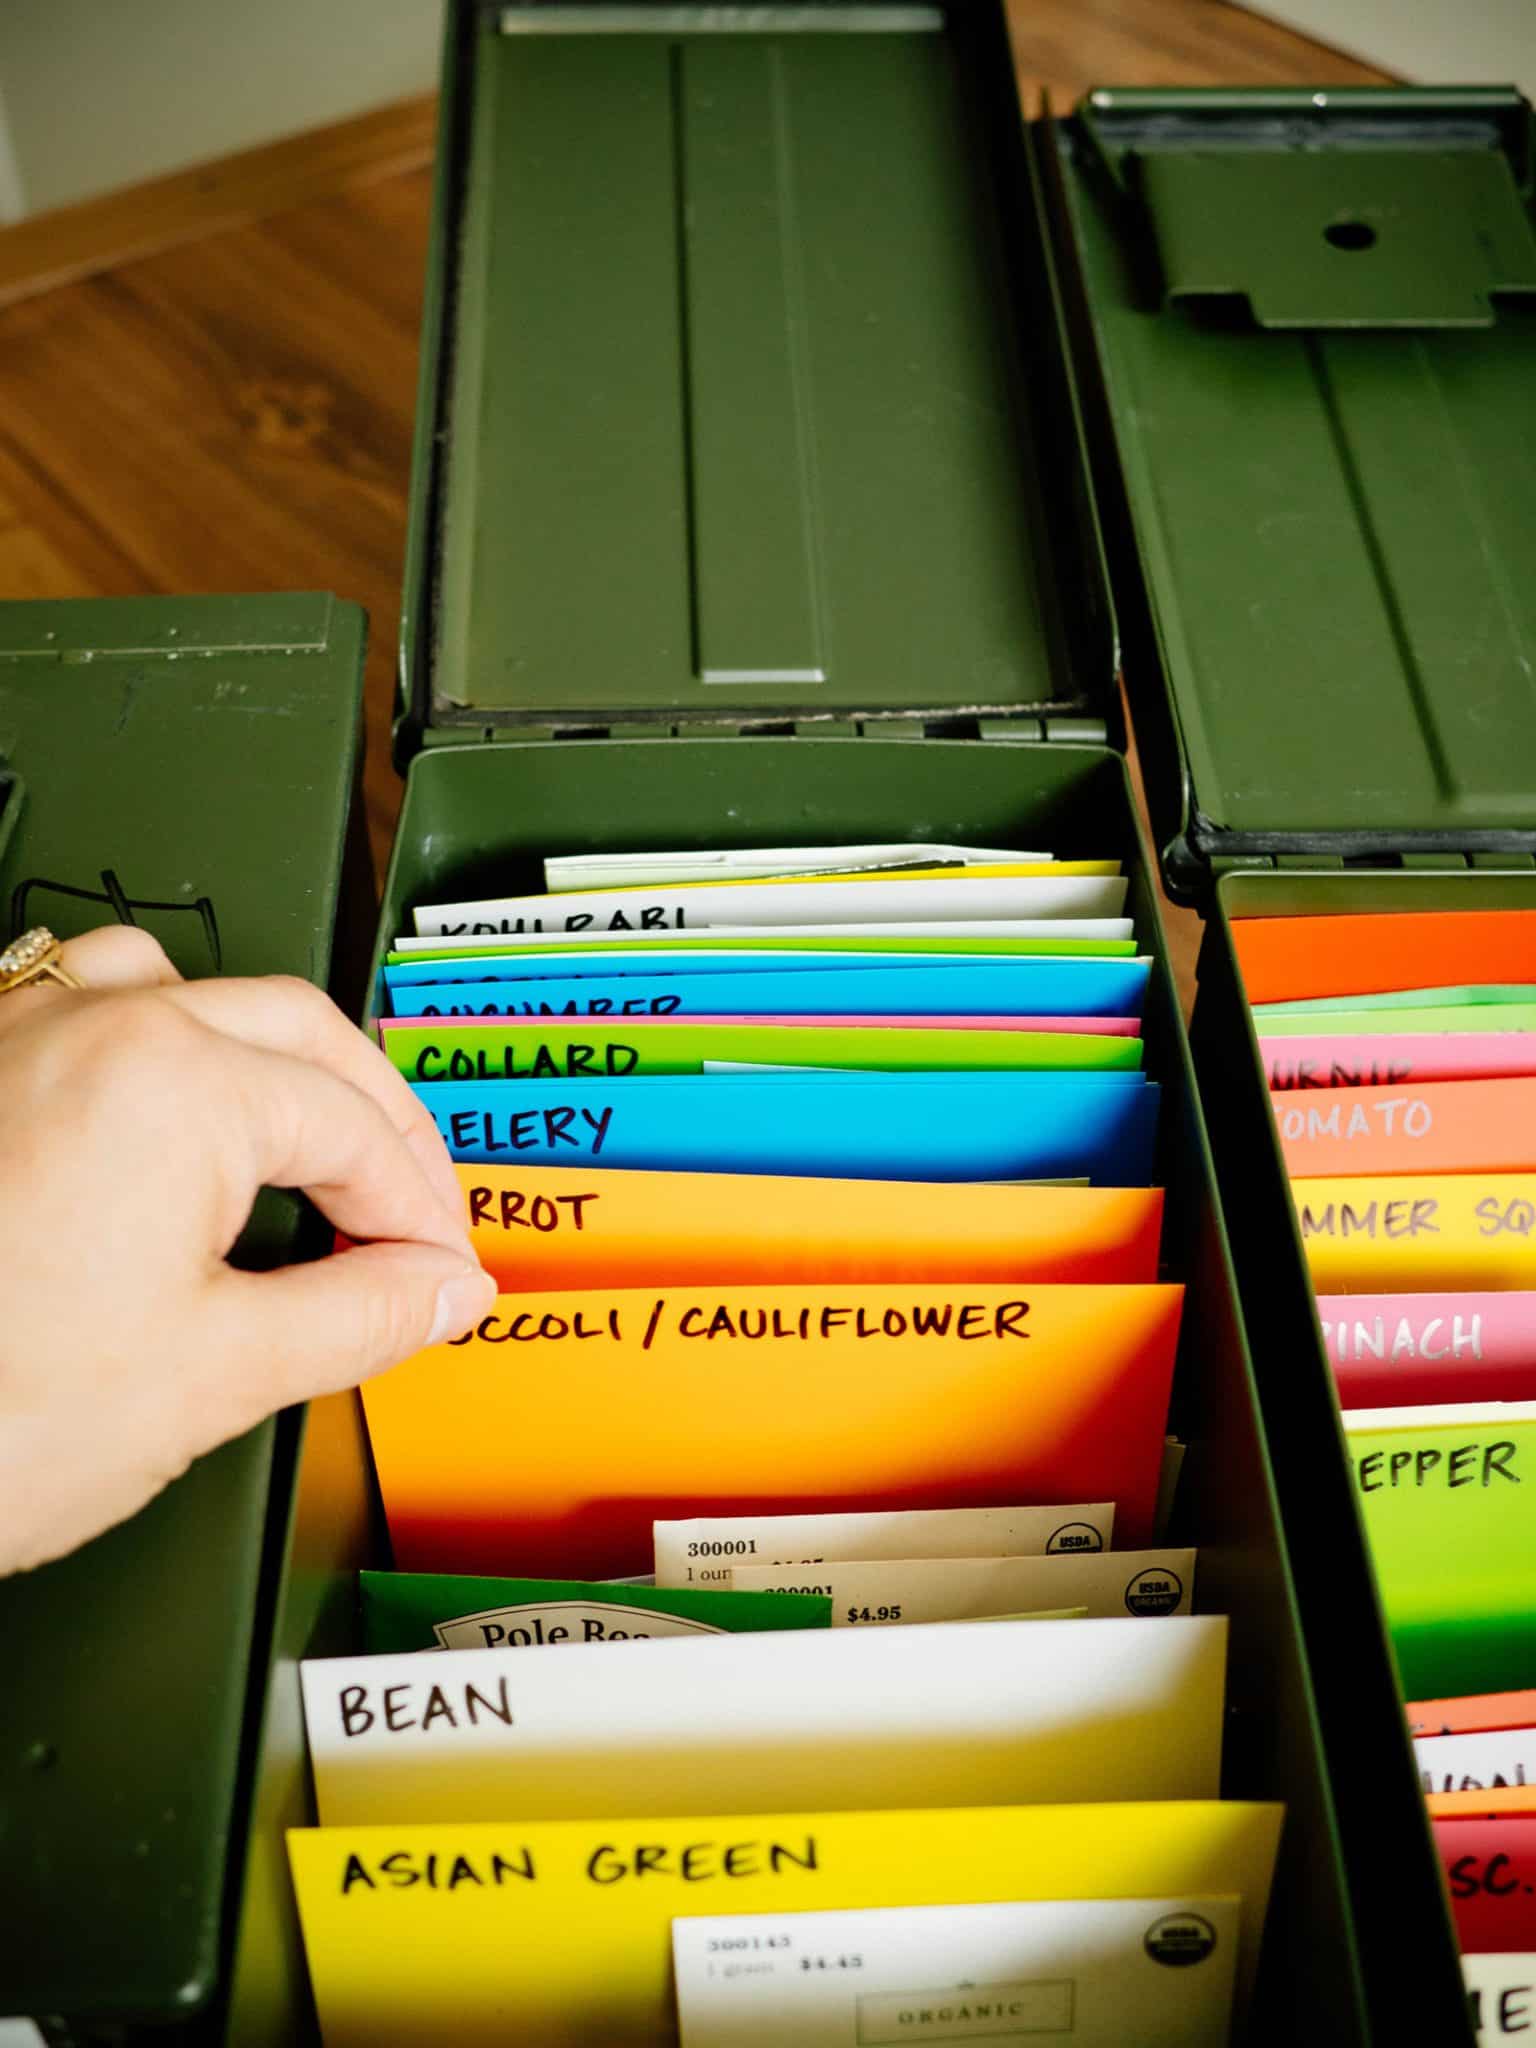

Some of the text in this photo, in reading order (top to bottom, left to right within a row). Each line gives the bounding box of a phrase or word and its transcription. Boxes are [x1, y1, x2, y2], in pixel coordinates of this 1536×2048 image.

[415, 1043, 639, 1082] COLLARD
[1271, 1056, 1413, 1090] URNIP
[469, 1187, 600, 1232] RROT
[1301, 1196, 1536, 1239] MMER SQ
[643, 1300, 664, 1349] /
[678, 1301, 1031, 1341] CAULIFLOWER
[1358, 1441, 1522, 1493] EPPER
[688, 1540, 757, 1557] 300001
[1059, 1536, 1091, 1548] USDA
[847, 1606, 902, 1623] $4.95
[340, 1676, 513, 1736] BEAN
[341, 1835, 819, 1895] ASIAN GREEN
[1449, 1853, 1534, 1898] SC.
[897, 2001, 1024, 2025] ORGANIC
